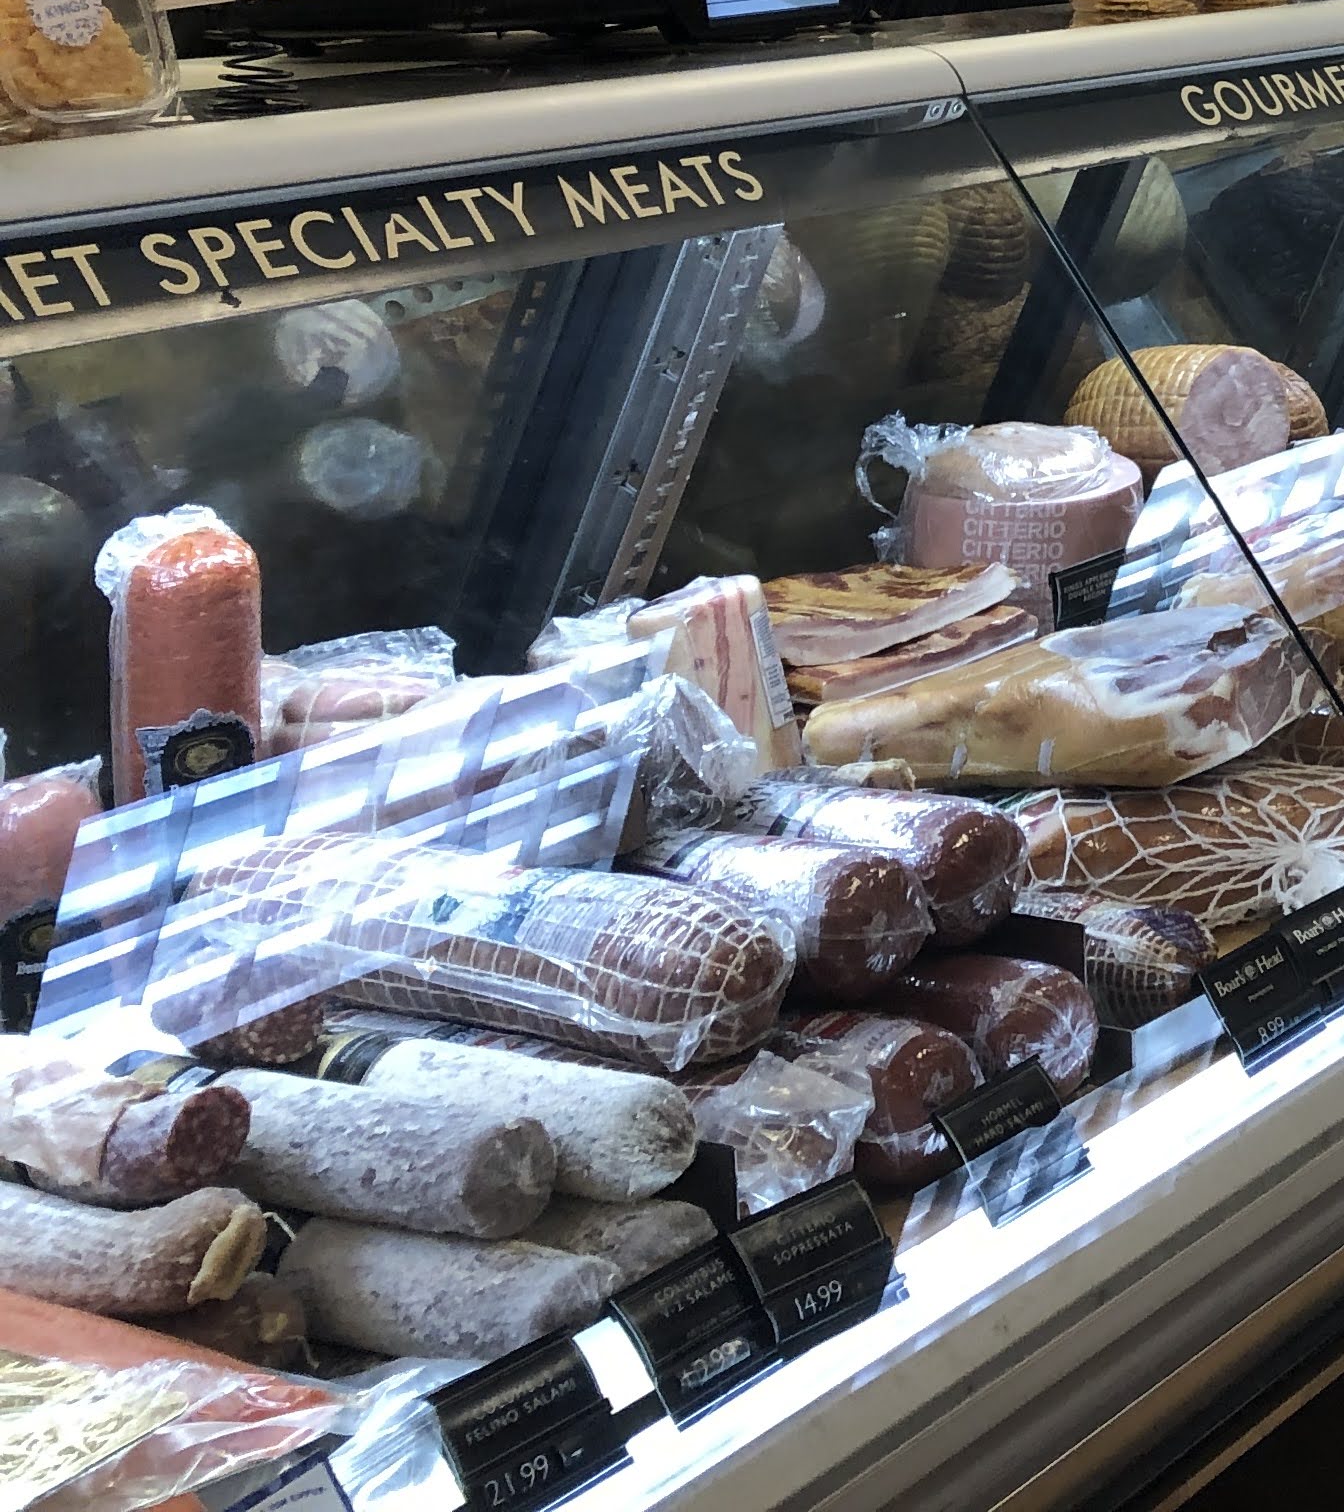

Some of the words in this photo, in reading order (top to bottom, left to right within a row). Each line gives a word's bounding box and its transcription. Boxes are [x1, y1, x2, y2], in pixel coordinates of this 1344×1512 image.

[140, 180, 536, 296] SPECIALTY
[557, 152, 765, 230] MEATS
[963, 518, 1067, 539] CITTERIO
[962, 539, 1064, 560] CITTERIO
[1292, 919, 1325, 945] Boar's
[1213, 968, 1247, 997] Boar's
[1255, 946, 1285, 974] Head
[1257, 1016, 1285, 1046] 8.99
[981, 1096, 1024, 1126] HORMEL
[794, 1279, 843, 1321] 14.99
[484, 1454, 549, 1506] 21.99
